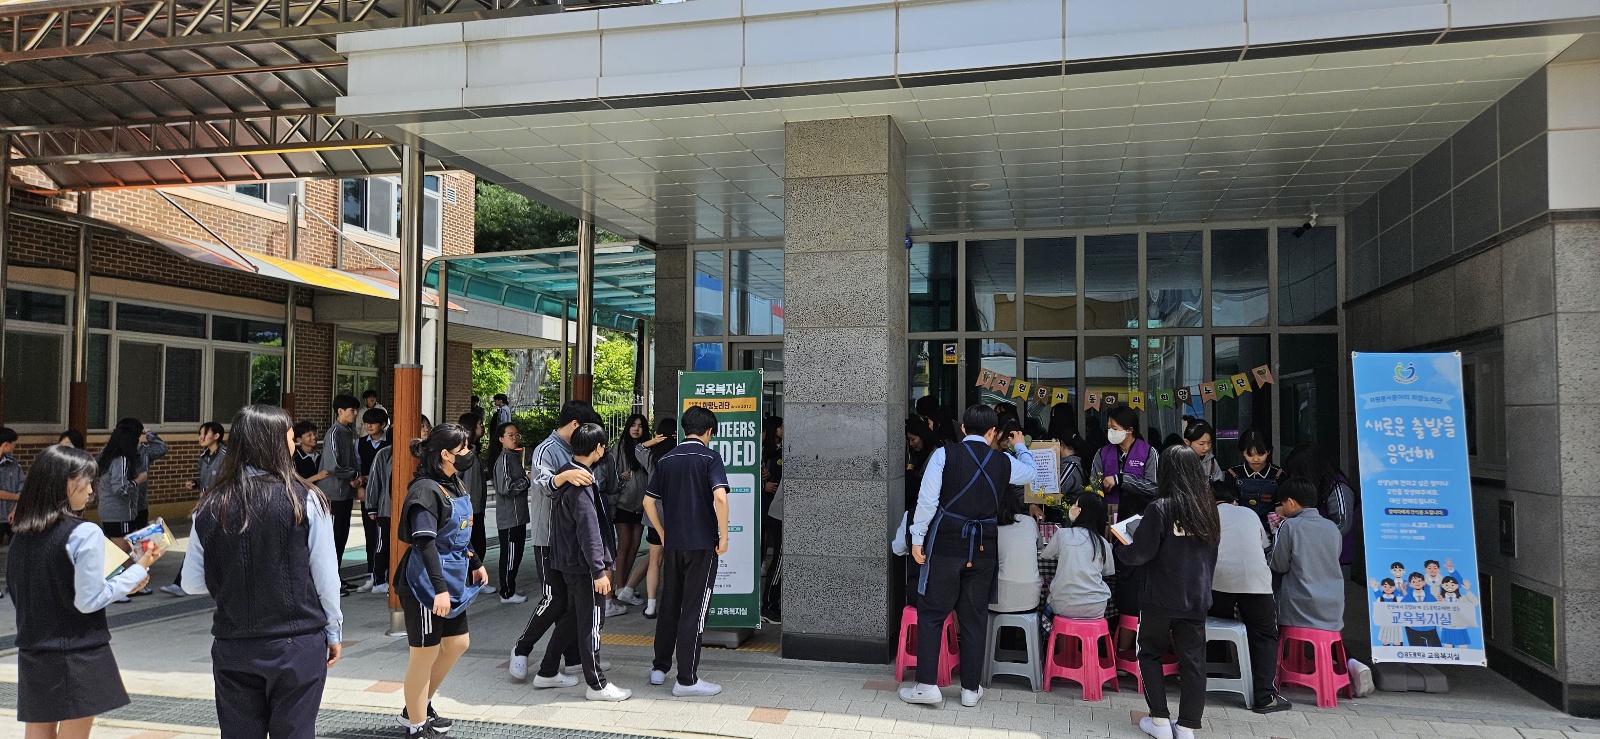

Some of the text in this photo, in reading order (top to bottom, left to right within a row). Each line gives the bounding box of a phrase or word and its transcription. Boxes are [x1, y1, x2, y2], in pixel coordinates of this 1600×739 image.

[694, 382, 746, 396] 교육복지실
[1089, 394, 1141, 404] 동아리
[1160, 377, 1246, 401] 희망노리단
[1411, 394, 1443, 404] 희망노리단
[713, 421, 756, 438] TEERS
[1365, 415, 1456, 440] 새로운 출발을
[708, 440, 756, 467] DED
[1386, 443, 1435, 465] 응원해
[717, 607, 748, 616] 교육복지실
[1391, 611, 1453, 626] 교육복지실
[1427, 652, 1460, 661] 교육복지실
